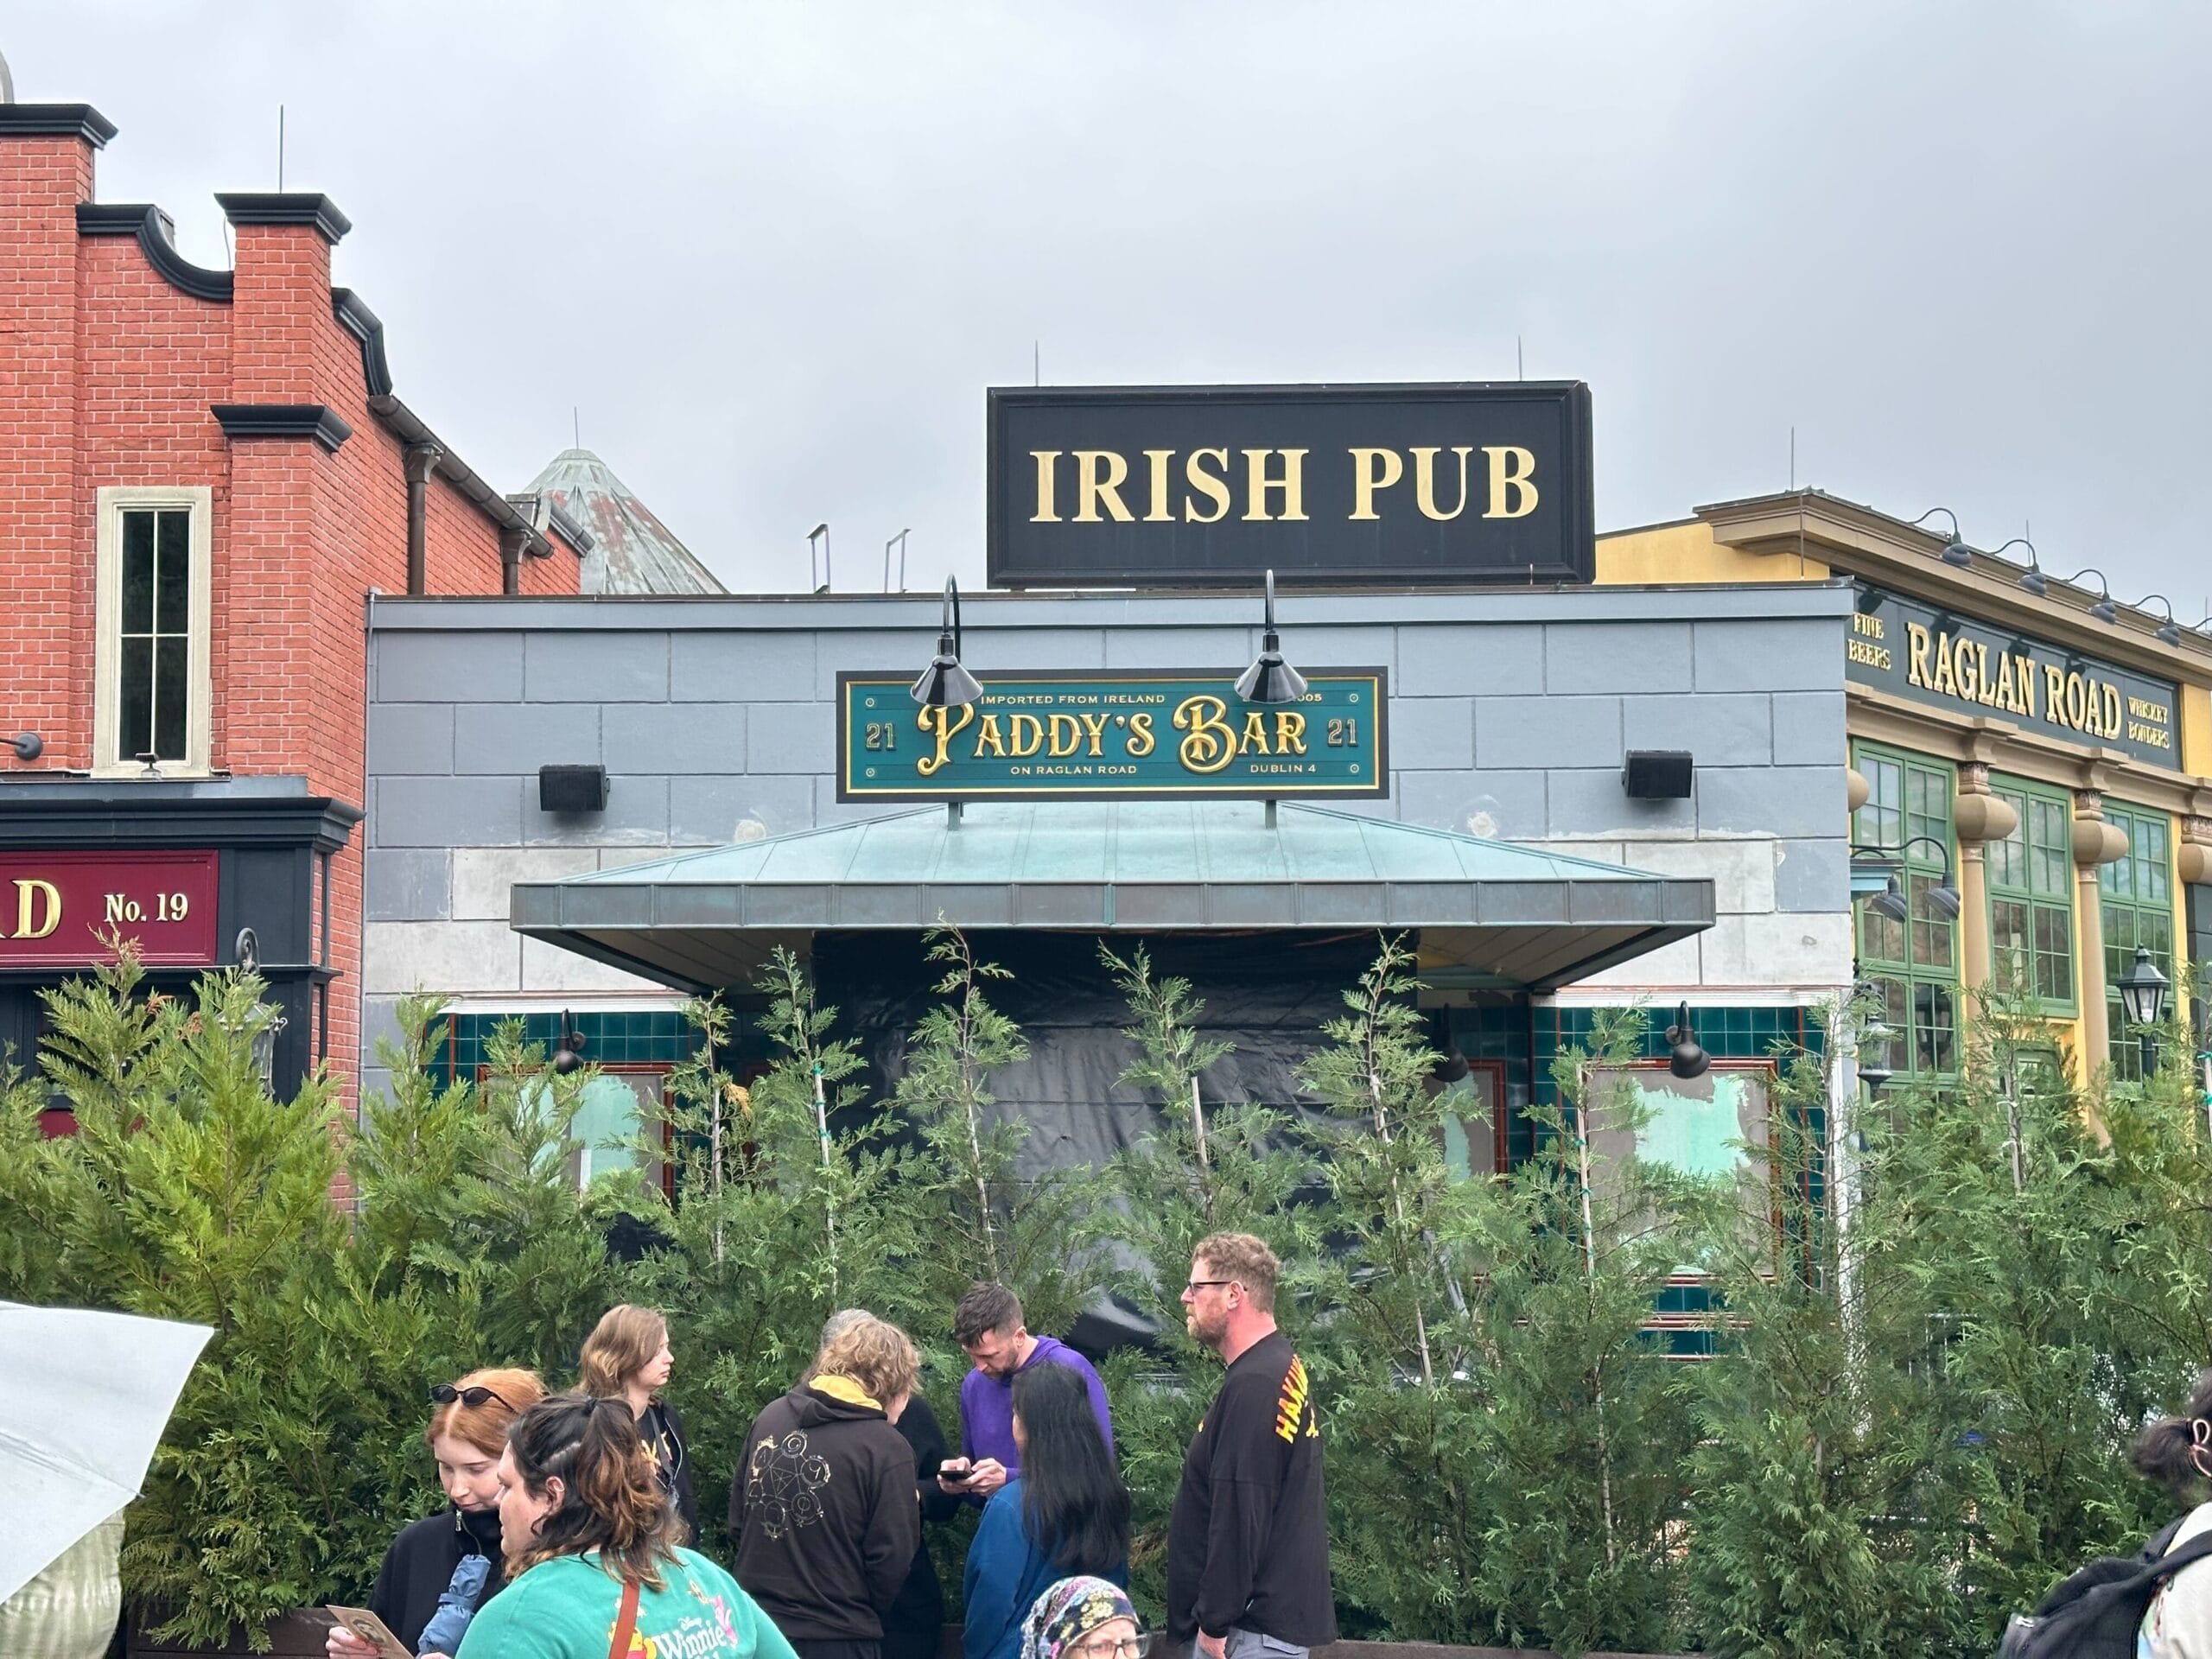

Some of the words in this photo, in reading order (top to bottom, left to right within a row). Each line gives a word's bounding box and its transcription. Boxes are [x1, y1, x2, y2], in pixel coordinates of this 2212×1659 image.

[1029, 447, 1310, 523] IRISH
[1348, 446, 1539, 521] PUB
[1853, 611, 1885, 639] FINE
[1847, 638, 1891, 671] BEERS
[1906, 621, 2036, 717] RAGLAN
[2044, 664, 2122, 741] ROAD
[981, 696, 1054, 705] IMPORTED
[1058, 695, 1098, 704] FROM
[1103, 695, 1166, 703] IRELAND
[1293, 693, 1323, 702] 005
[2127, 696, 2168, 724] WHISKEY
[866, 722, 895, 749] 21
[917, 702, 1155, 776] PADDY'S
[1173, 695, 1307, 772] BAR
[1327, 718, 1357, 746] 21
[2127, 721, 2171, 750] BONDERS
[1010, 766, 1031, 775] ON
[1036, 766, 1092, 775] RAGLAN
[1097, 766, 1137, 774] ROAD
[1250, 764, 1303, 773] DUBLIN
[1307, 764, 1317, 772] 4
[0, 879, 62, 939] D
[103, 893, 147, 922] No.
[156, 893, 188, 922] 19
[651, 1619, 727, 1659] Winnie
